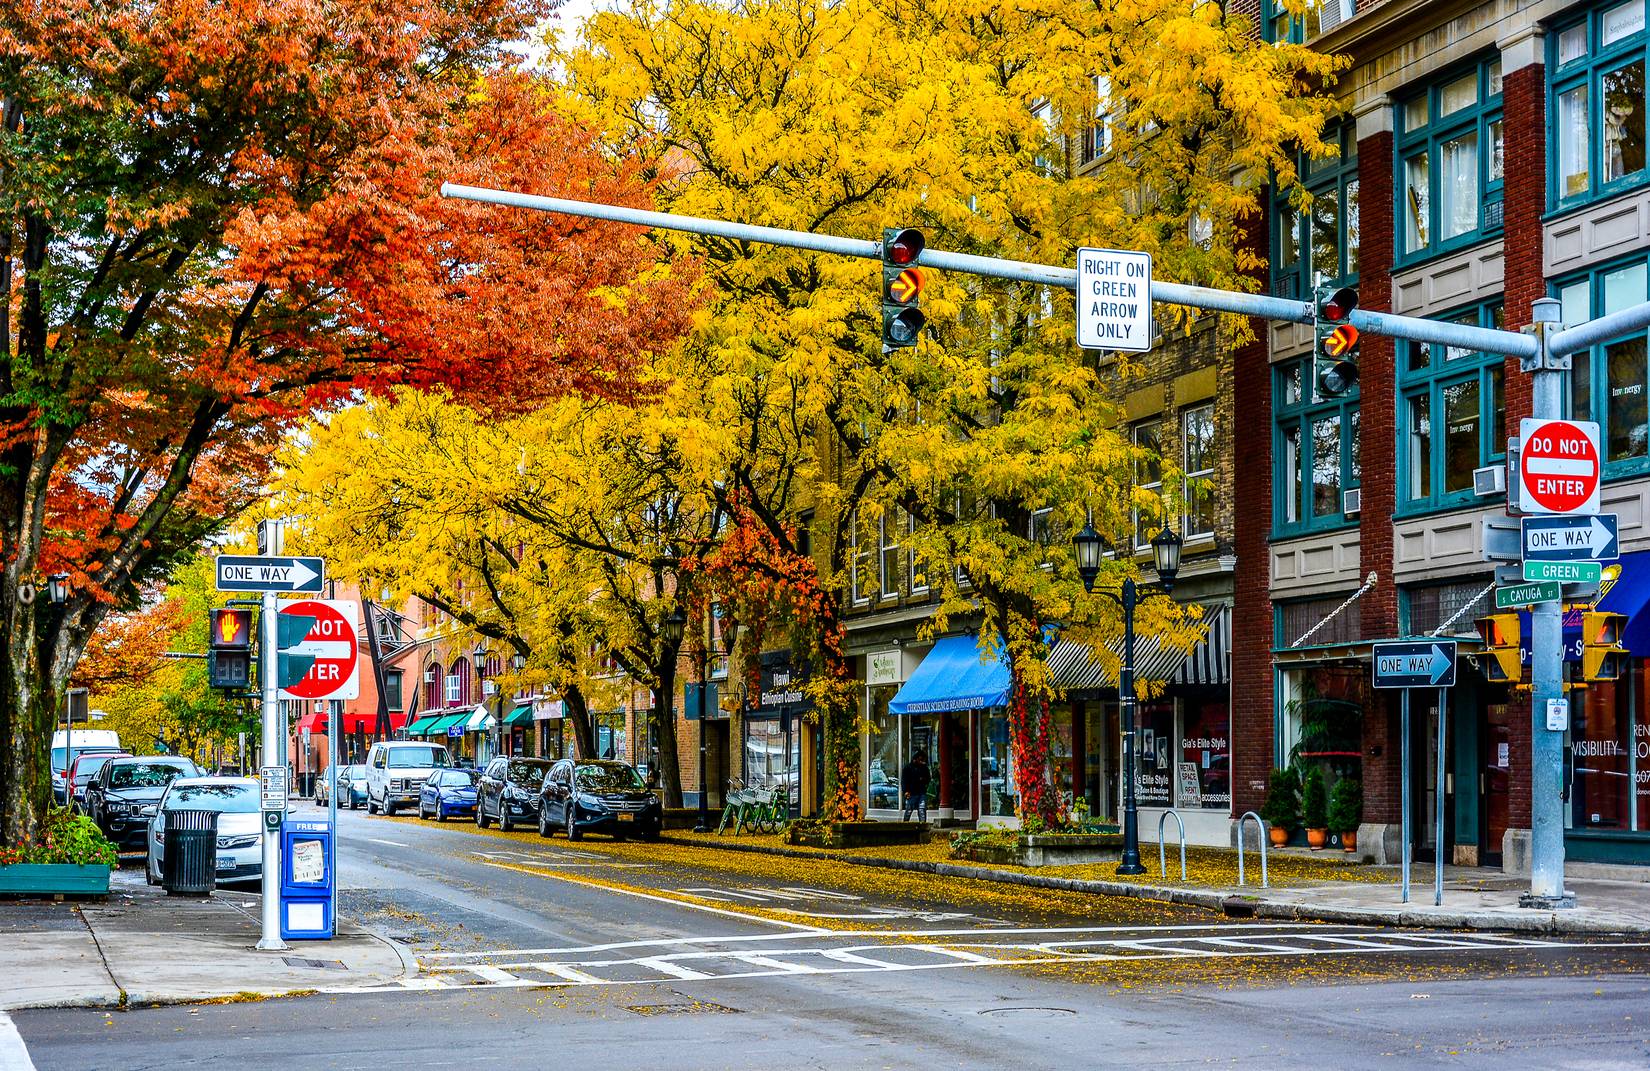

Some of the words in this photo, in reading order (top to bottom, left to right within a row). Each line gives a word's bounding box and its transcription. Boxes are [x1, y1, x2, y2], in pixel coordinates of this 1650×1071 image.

[1084, 259, 1121, 276] RIGHT
[1126, 262, 1144, 278] ON
[1092, 280, 1136, 298] GREEN
[1091, 301, 1138, 318] ARROW
[1096, 322, 1132, 339] ONLY
[1532, 437, 1552, 453] DO
[1559, 439, 1588, 455] NOT
[1537, 479, 1585, 496] ENTER
[1531, 532, 1558, 547] ONE
[1564, 530, 1593, 545] WAY
[224, 566, 253, 580] ONE
[260, 567, 290, 581] WAY
[1530, 569, 1536, 577] E
[1542, 565, 1580, 579] GREEN
[1510, 587, 1542, 602] CAYUGA
[1547, 590, 1553, 598] ST
[309, 620, 344, 636] NOT
[308, 664, 340, 681] TER
[1381, 658, 1402, 673] ONE
[1408, 657, 1433, 672] WAY
[761, 691, 784, 707] Ethiopian
[785, 690, 802, 703] Cuisine
[907, 702, 930, 713] CHRISTIAN
[930, 700, 949, 711] SCIENCE
[949, 698, 970, 711] READING
[970, 696, 984, 709] ROOM
[1182, 738, 1196, 749] Gia's
[1197, 738, 1210, 748] Elite
[1211, 737, 1226, 751] Style
[1571, 740, 1619, 757] VISIBILITY
[1634, 741, 1650, 758] LO
[1180, 764, 1196, 772] RETAIL
[1142, 774, 1154, 785] Elite
[1155, 774, 1168, 787] Style
[1182, 773, 1197, 781] SPACE
[1185, 786, 1197, 794] RENT
[1201, 791, 1230, 802] accessories
[296, 823, 317, 831] FREE
